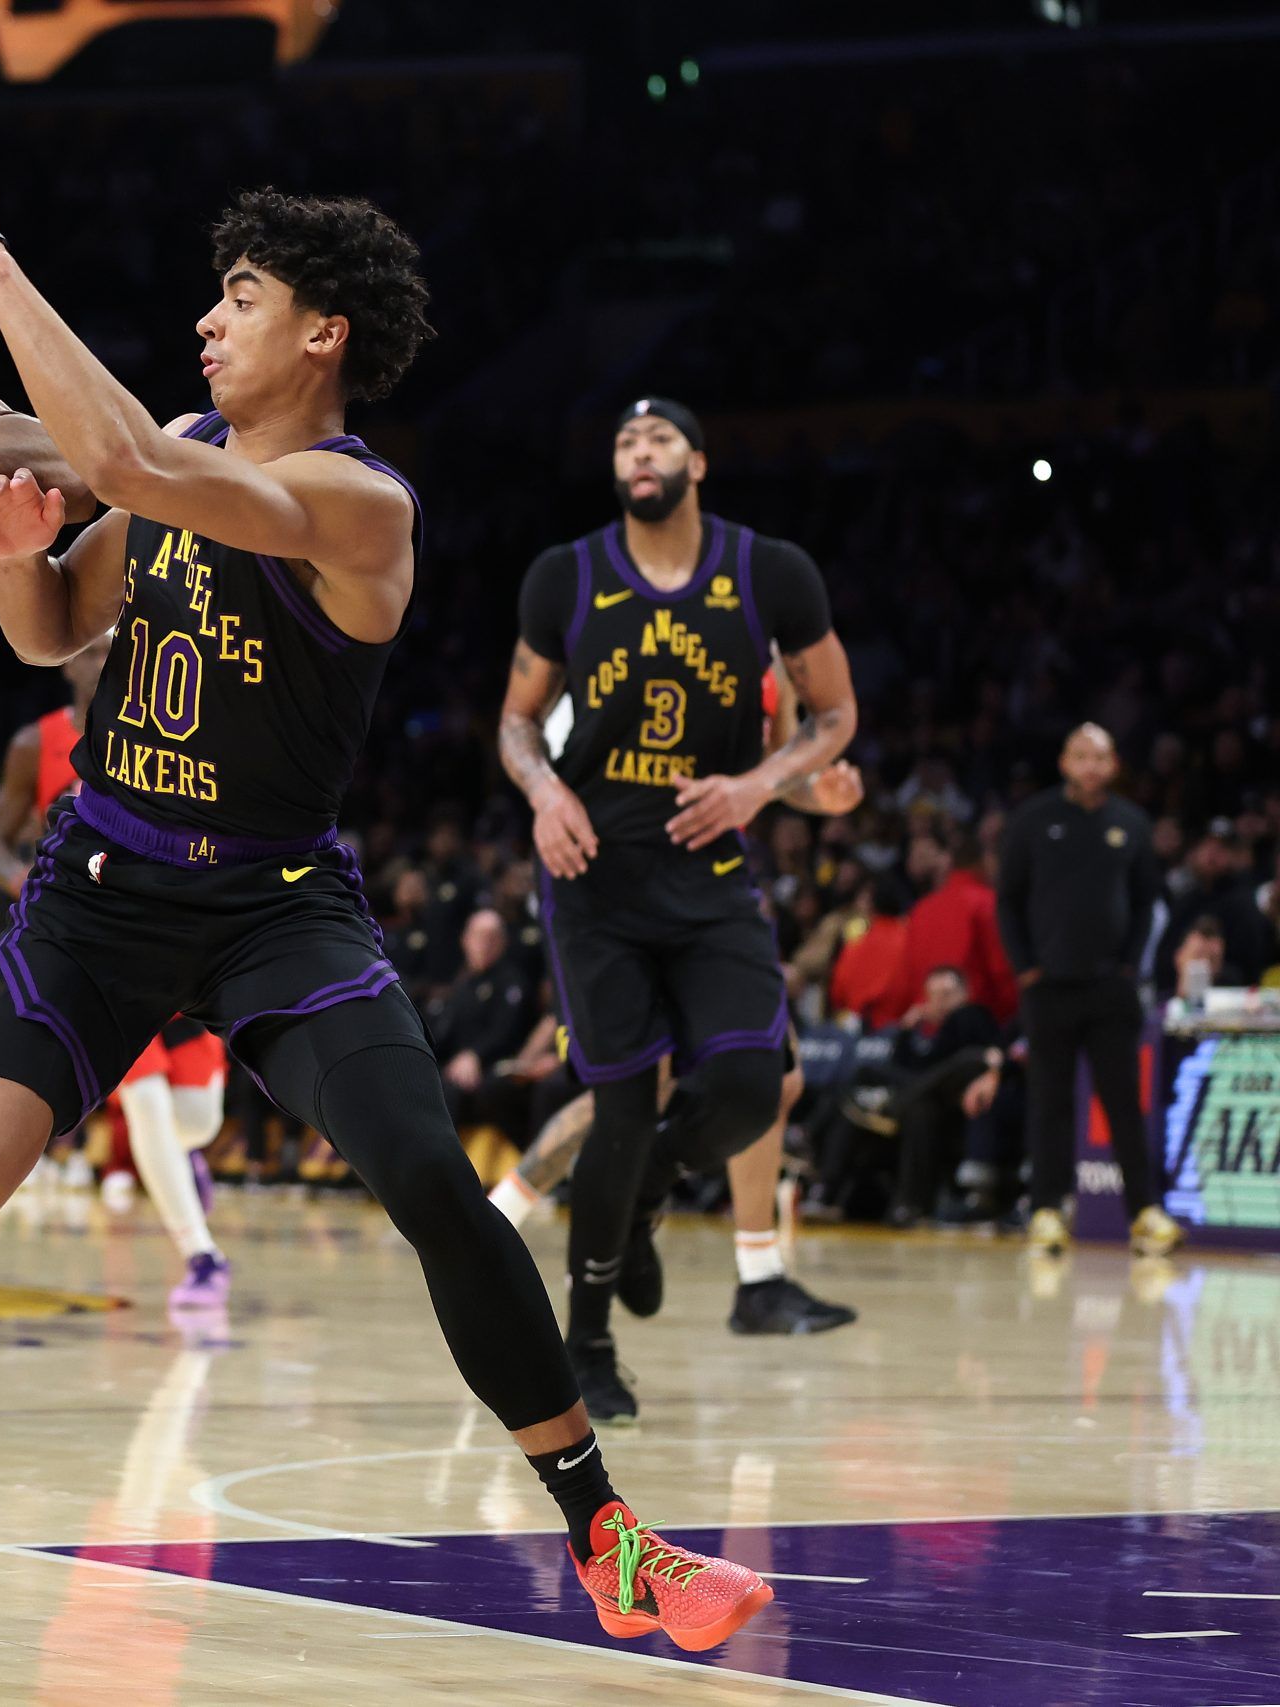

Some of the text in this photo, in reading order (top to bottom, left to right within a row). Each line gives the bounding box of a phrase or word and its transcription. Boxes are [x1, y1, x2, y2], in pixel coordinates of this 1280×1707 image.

[148, 528, 263, 684] ANGELES
[117, 617, 203, 742] 10
[588, 609, 739, 708] LOS ANGELES
[639, 679, 687, 750] 3
[105, 730, 218, 802] LAKERS
[188, 836, 218, 864] LAL
